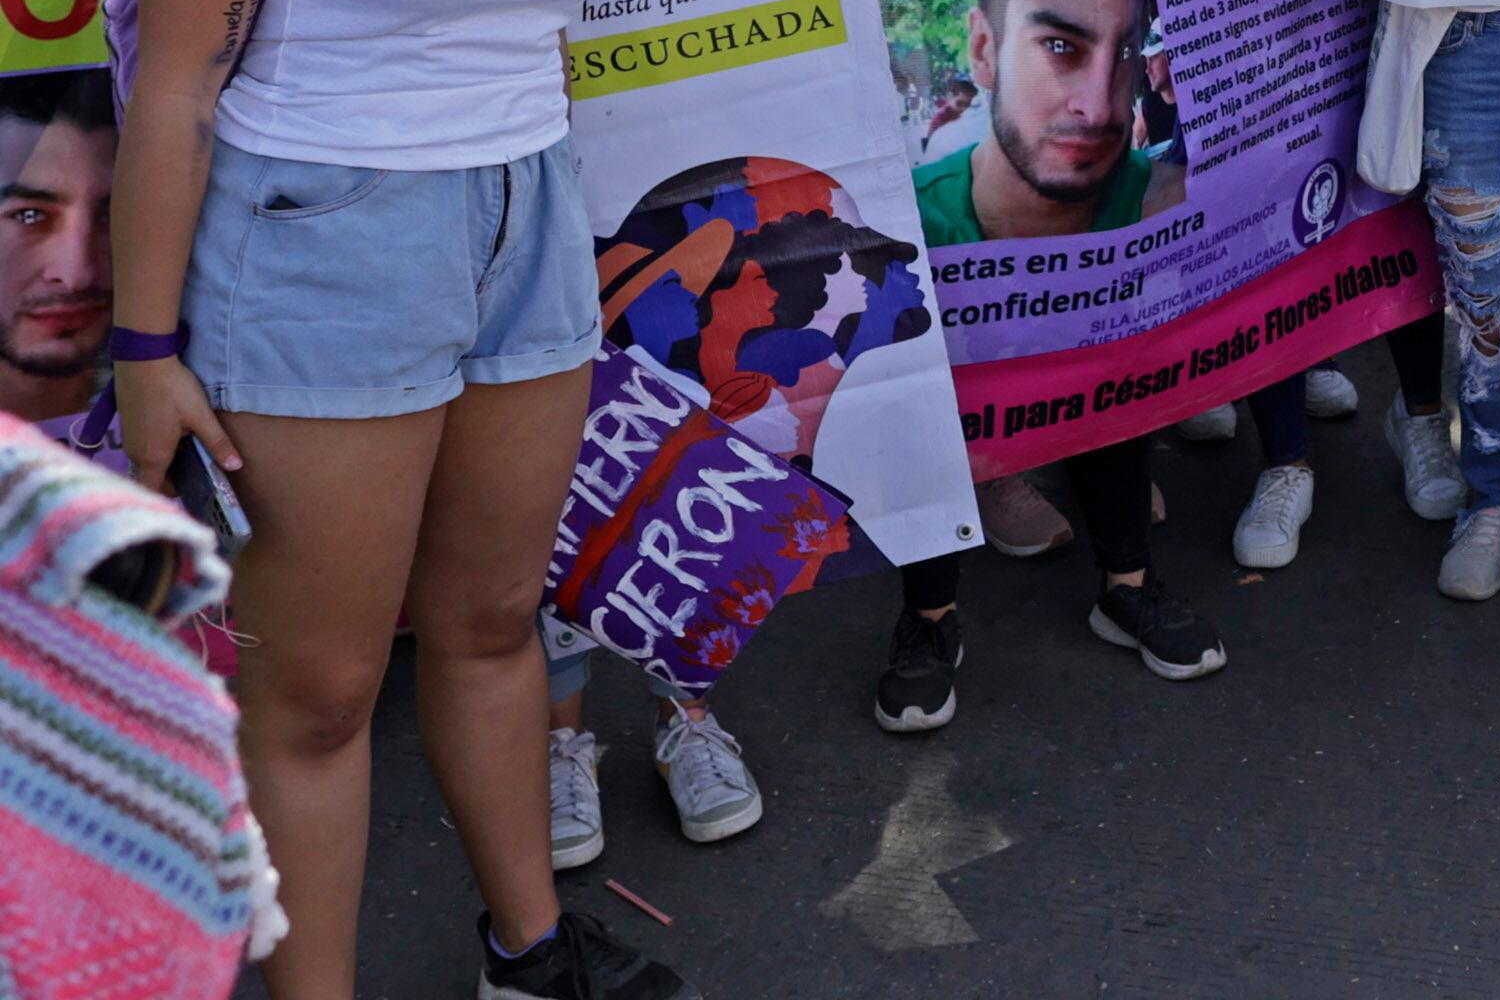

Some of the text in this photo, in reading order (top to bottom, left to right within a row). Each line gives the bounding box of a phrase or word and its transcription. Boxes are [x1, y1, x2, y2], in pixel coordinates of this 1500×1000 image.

[1164, 9, 1197, 35] edad
[1199, 3, 1214, 23] de
[1167, 29, 1222, 64] presenta
[1224, 12, 1260, 40] signos
[1174, 5, 1325, 85] muchas mañas omisiones
[1180, 58, 1316, 134] menor hija arrebatandola
[1192, 37, 1312, 105] legales logra guarda
[1201, 79, 1321, 151] madre, autoridades
[1286, 124, 1323, 153] sexual.
[1191, 128, 1275, 177] menor manos
[1025, 210, 1205, 274] en su contra
[1197, 202, 1278, 251] ALIMENTARIOS
[1090, 237, 1291, 333] SI LA JUSTICIA NO LOS ALCANZA
[1180, 245, 1229, 277] PUEBLA
[940, 271, 1144, 328] confidencial
[1004, 392, 1084, 435] para
[1093, 364, 1180, 409] César
[1265, 294, 1332, 344] Flores
[1334, 248, 1419, 305] Idalgo
